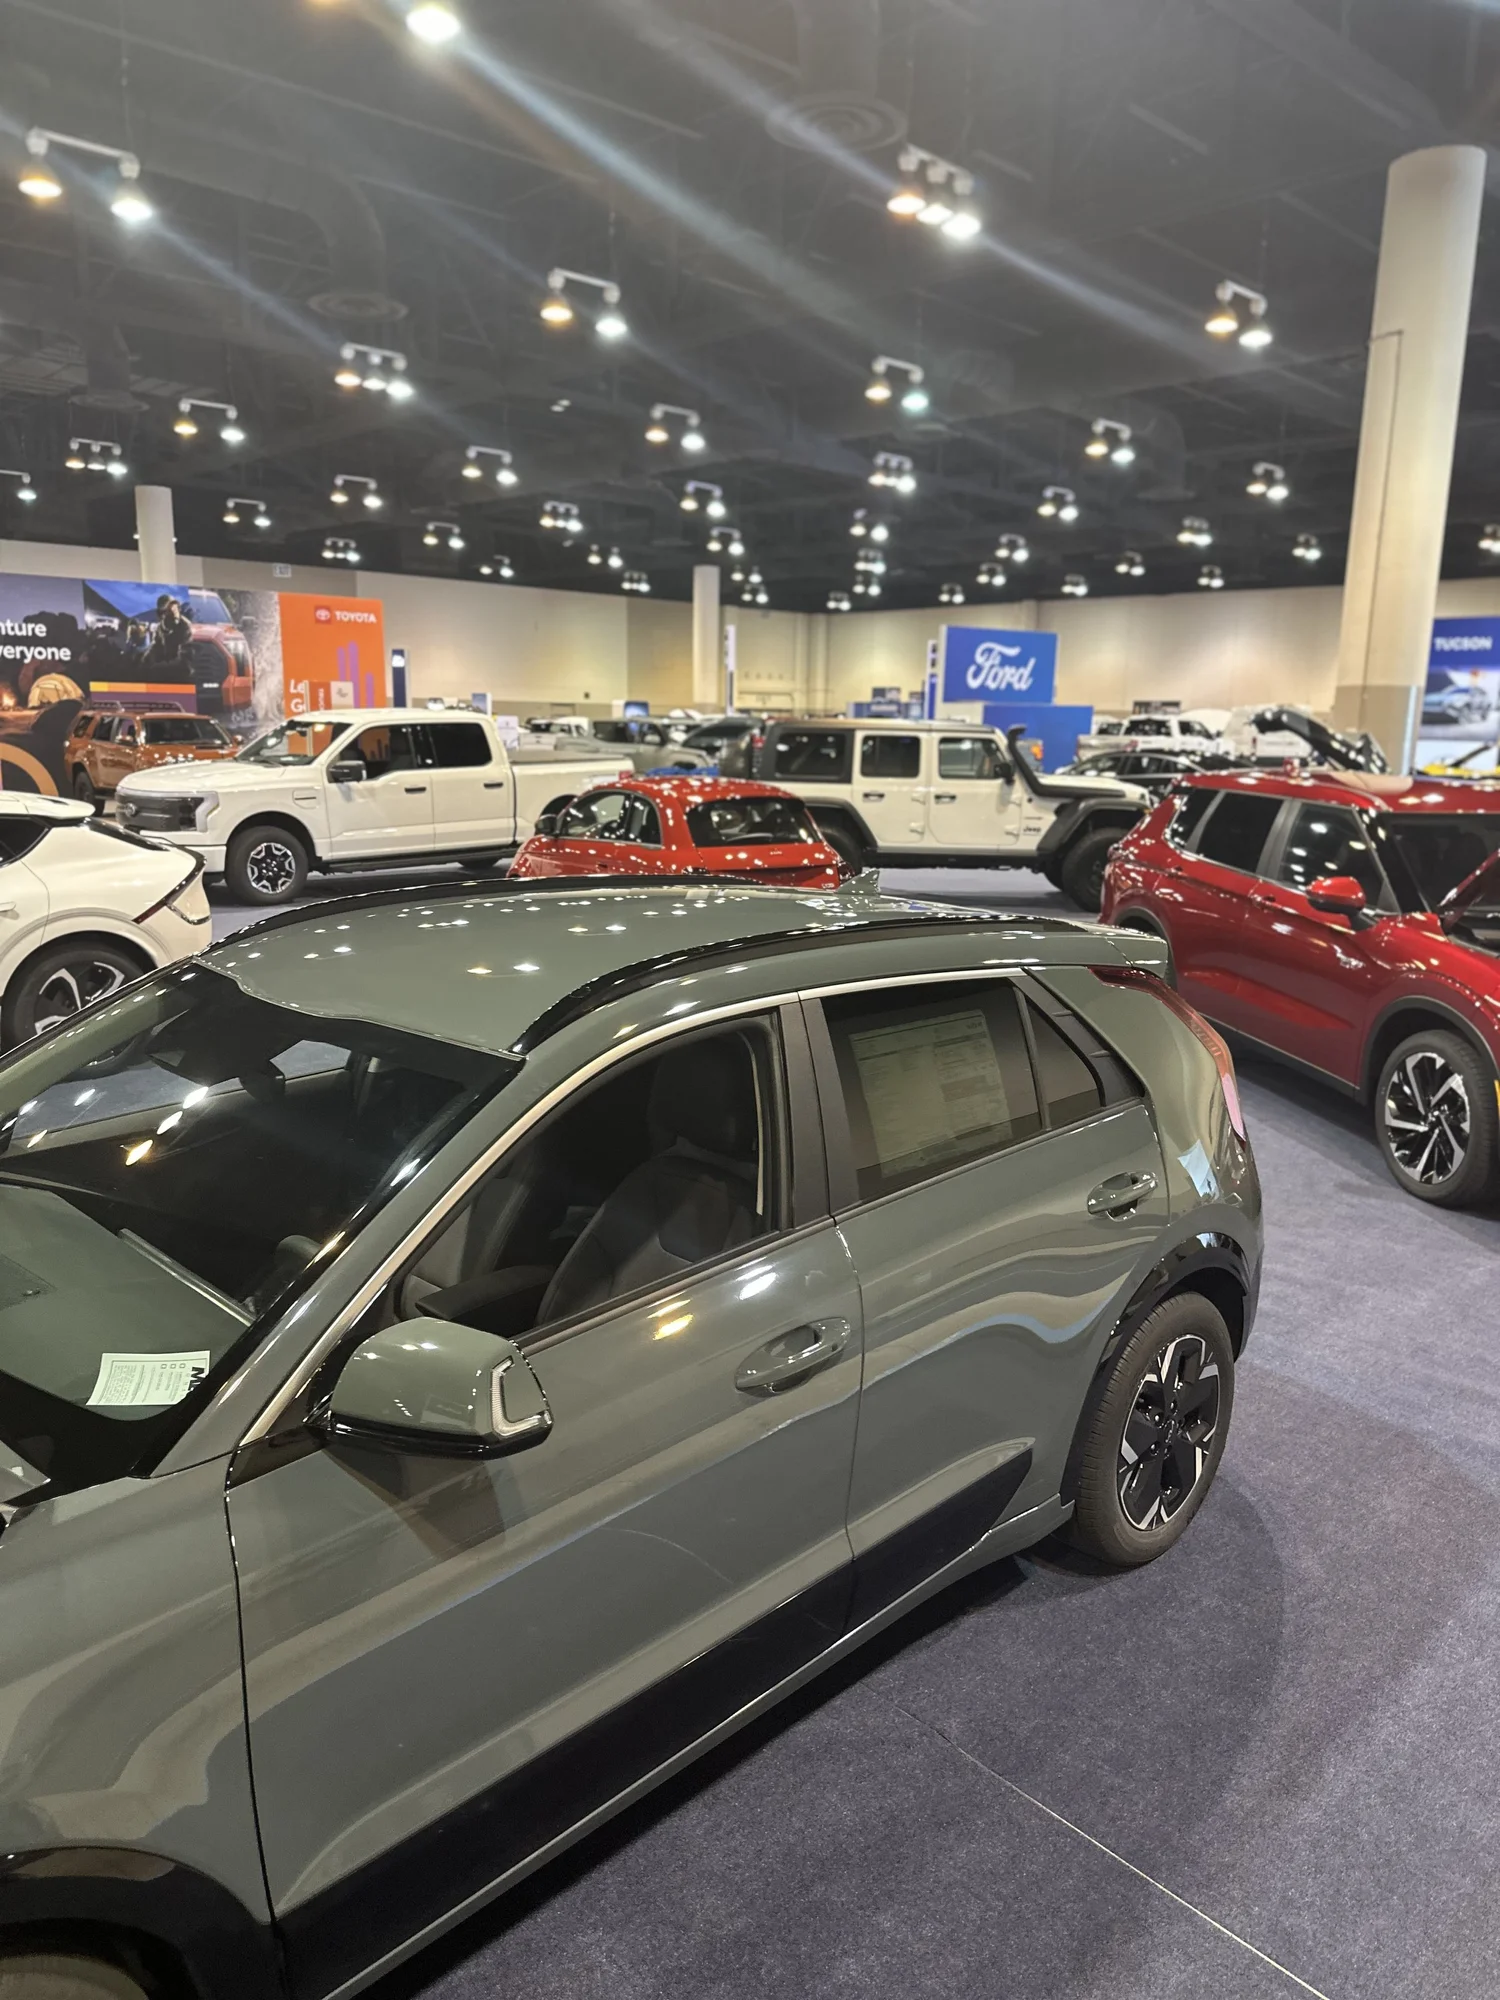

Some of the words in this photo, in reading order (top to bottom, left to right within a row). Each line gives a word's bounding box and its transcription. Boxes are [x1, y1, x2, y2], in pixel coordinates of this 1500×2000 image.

[334, 610, 377, 623] TOYOTA
[1434, 635, 1493, 651] TUCSON
[966, 641, 1036, 691] Ford
